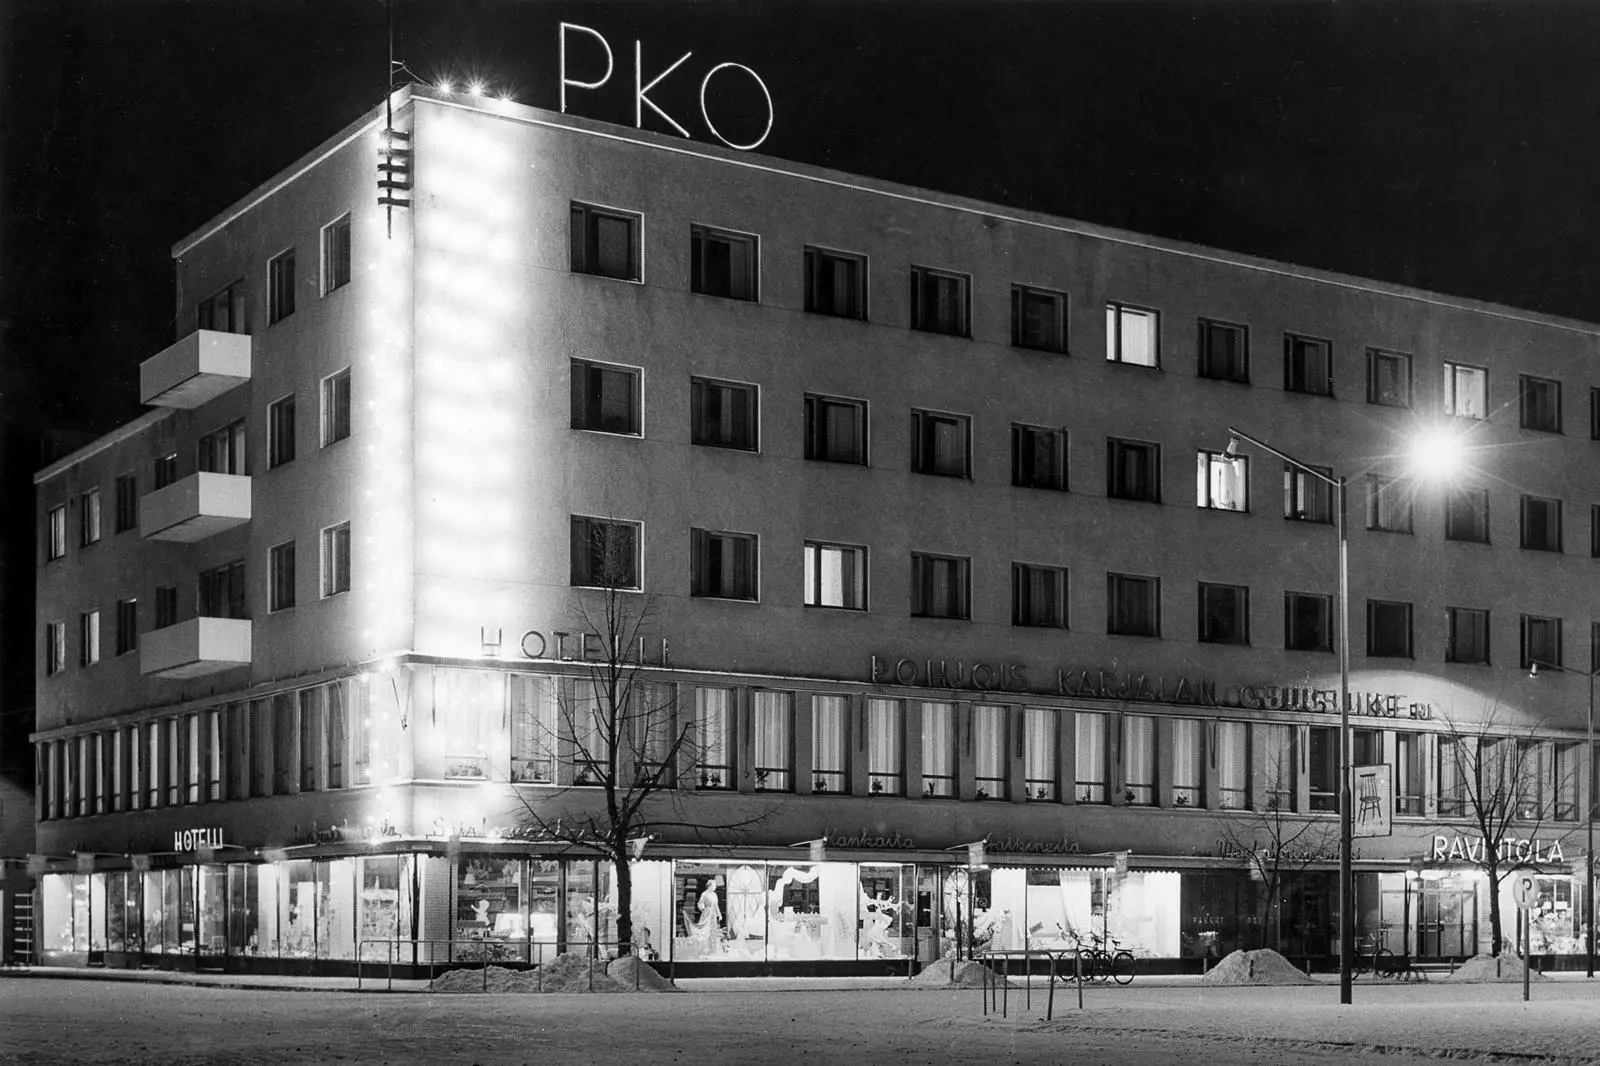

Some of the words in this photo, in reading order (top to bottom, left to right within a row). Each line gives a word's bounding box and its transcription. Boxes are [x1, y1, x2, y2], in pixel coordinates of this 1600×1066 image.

[560, 21, 773, 150] PKO
[870, 654, 1028, 692] POHJOIS
[1057, 667, 1217, 706] KARJALAN
[174, 827, 223, 851] HOTELLI
[1431, 835, 1565, 864] RAVINTOLA
[1522, 878, 1533, 903] P
